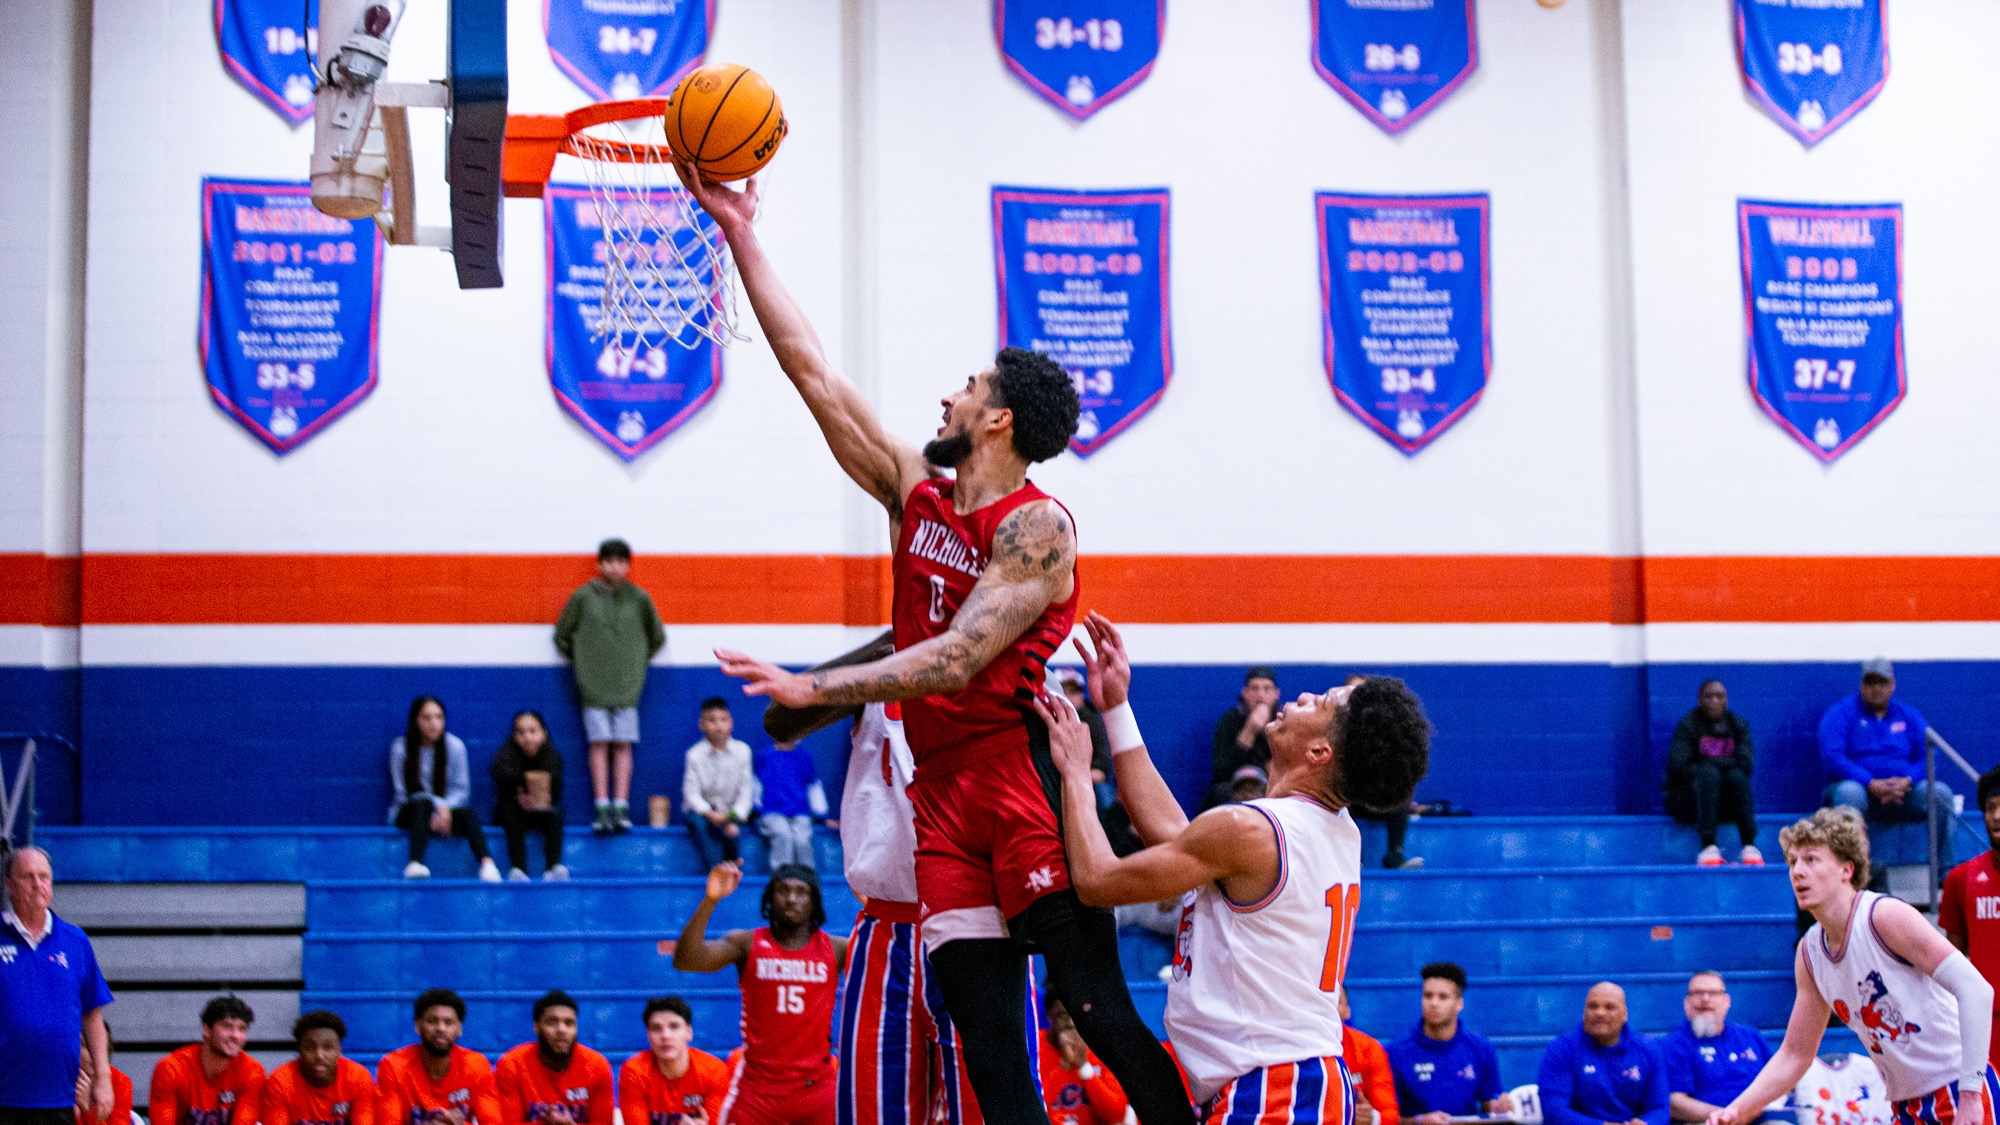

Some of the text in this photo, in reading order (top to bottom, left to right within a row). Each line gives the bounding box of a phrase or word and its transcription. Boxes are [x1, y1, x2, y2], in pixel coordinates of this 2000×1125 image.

[599, 25, 657, 55] 24-7
[1035, 17, 1123, 51] 34-13
[235, 205, 354, 235] BASKETBALL
[1026, 218, 1138, 247] BASKETBALL
[1350, 218, 1460, 246] BASKETBALL
[1768, 218, 1875, 248] VOLLEYBALL
[233, 240, 357, 265] 2001-02
[244, 280, 338, 296] CONFERENCE
[1804, 282, 1878, 299] CHAMPIONS
[1038, 290, 1128, 305] CONFERENCE
[1361, 289, 1450, 305] CONFERENCE
[245, 299, 340, 314] TOURNAMENT
[1363, 306, 1453, 321] TOURNAMENT
[1819, 300, 1894, 317] CHAMPIONS
[250, 313, 336, 328] CHAMPIONS
[1038, 309, 1129, 323] TOURNAMENT
[1044, 322, 1124, 337] CHAMPIONS
[1369, 320, 1449, 335] CHAMPIONS
[1808, 318, 1871, 333] NATIONAL
[274, 331, 344, 346] NATIONAL
[1068, 339, 1134, 353] NATIONAL
[1394, 337, 1460, 352] NATIONAL
[243, 345, 338, 360] TOURNAMENT
[1366, 351, 1456, 366] TOURNAMENT
[597, 347, 668, 379] 47-3
[1381, 367, 1436, 393] 33-4
[1794, 358, 1856, 390] 37-7
[1319, 883, 1361, 992] 10
[756, 957, 828, 983] NICHOLLS
[777, 985, 806, 1014] 15
